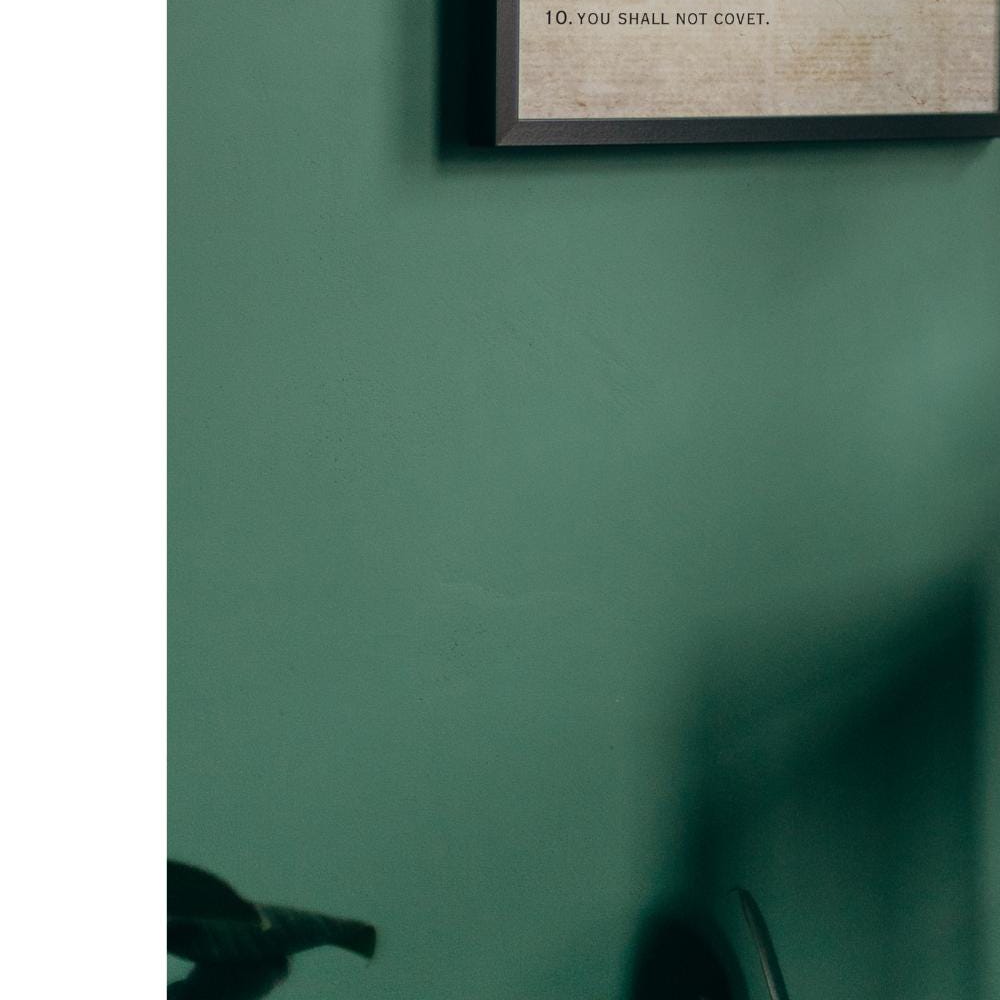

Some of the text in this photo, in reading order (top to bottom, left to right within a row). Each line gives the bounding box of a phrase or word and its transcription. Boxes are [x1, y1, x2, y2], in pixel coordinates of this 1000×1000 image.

[545, 9, 770, 26] 10. YOU SHALL NOT COVET.
